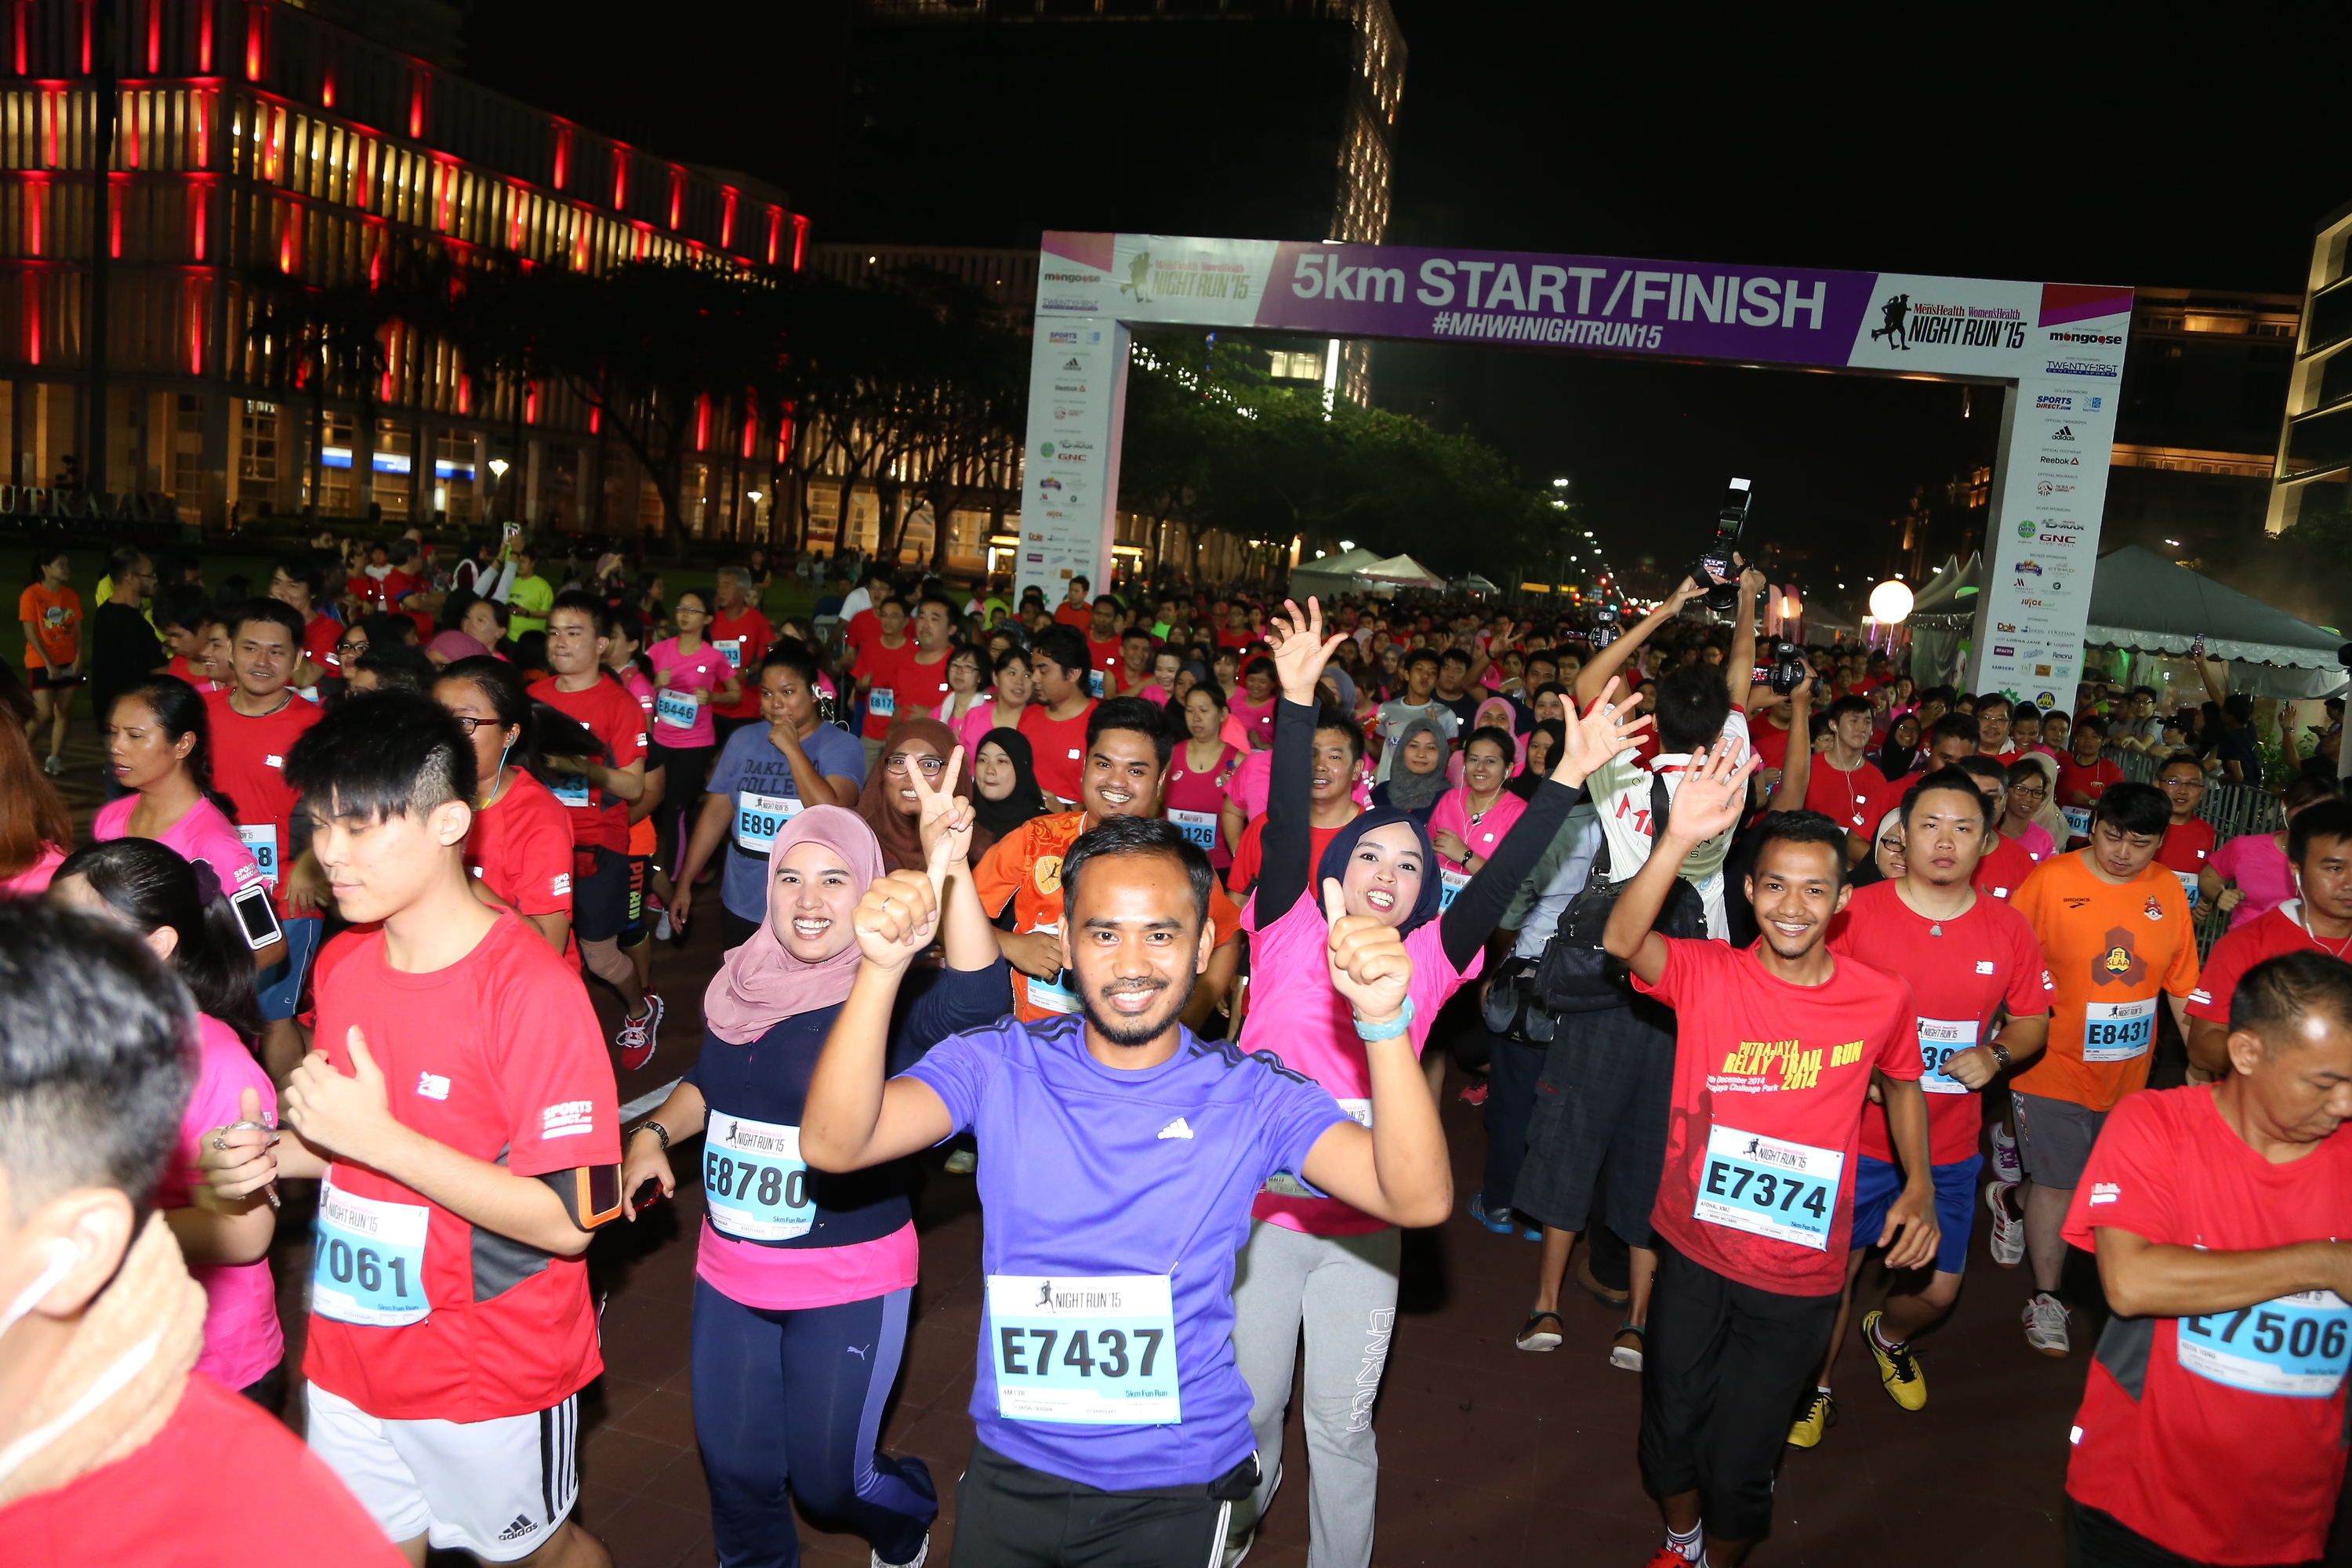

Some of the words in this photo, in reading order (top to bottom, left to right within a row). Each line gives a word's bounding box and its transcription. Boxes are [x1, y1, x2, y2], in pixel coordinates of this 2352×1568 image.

[1151, 270, 1197, 296] NIGHT
[1196, 273, 1228, 299] RUN
[1291, 254, 1406, 304] 5km
[1416, 259, 1827, 330] START/FINISH
[1432, 312, 1663, 350] #MHWHNIGHTRUN15
[1908, 316, 1965, 345] NIGHT
[1962, 319, 2005, 348] RUN
[2049, 331, 2122, 346] mongoose
[2037, 396, 2072, 405] SPORTS
[1058, 452, 1087, 462] GNC
[2040, 456, 2070, 465] Reebok
[2039, 534, 2076, 544] GNC
[1997, 622, 2016, 632] Dole
[2053, 652, 2073, 660] Rexona
[738, 777, 796, 796] COLLE
[742, 812, 788, 837] E894
[1180, 825, 1213, 844] 126
[554, 873, 570, 885] SPO
[1923, 1027, 1941, 1038] NIGHT
[1940, 1029, 1952, 1039] RUN
[2089, 1018, 2149, 1044] E8431
[1722, 1051, 1775, 1076] RELAY
[1779, 1048, 1823, 1075] TRAIL
[1830, 1040, 1864, 1068] RUN
[1738, 1039, 1800, 1058] PUTRAJAYA
[1716, 1075, 1748, 1085] December
[1748, 1076, 1766, 1085] 2014
[1729, 1083, 1762, 1094] Challenge
[1762, 1083, 1780, 1092] Park
[1780, 1069, 1820, 1091] 2014
[543, 1100, 593, 1120] SPORTS
[737, 1131, 759, 1148] NIGHT
[757, 1135, 775, 1151] RUN
[1758, 1147, 1781, 1163] NIGHT
[1780, 1152, 1799, 1167] RUN
[706, 1151, 811, 1209] E8780
[1706, 1160, 1827, 1219] E7374
[328, 1200, 349, 1222] NIGHT
[348, 1207, 366, 1229] RUN
[315, 1229, 408, 1298] 7061
[1055, 1292, 1085, 1308] NIGHT
[1086, 1292, 1107, 1308] RUN
[1108, 1291, 1121, 1308] '15
[1000, 1327, 1163, 1377] E7437
[1125, 1389, 1141, 1398] 5km
[1142, 1389, 1153, 1398] Fun
[1154, 1389, 1168, 1398] Run
[499, 1522, 539, 1541] adidas
